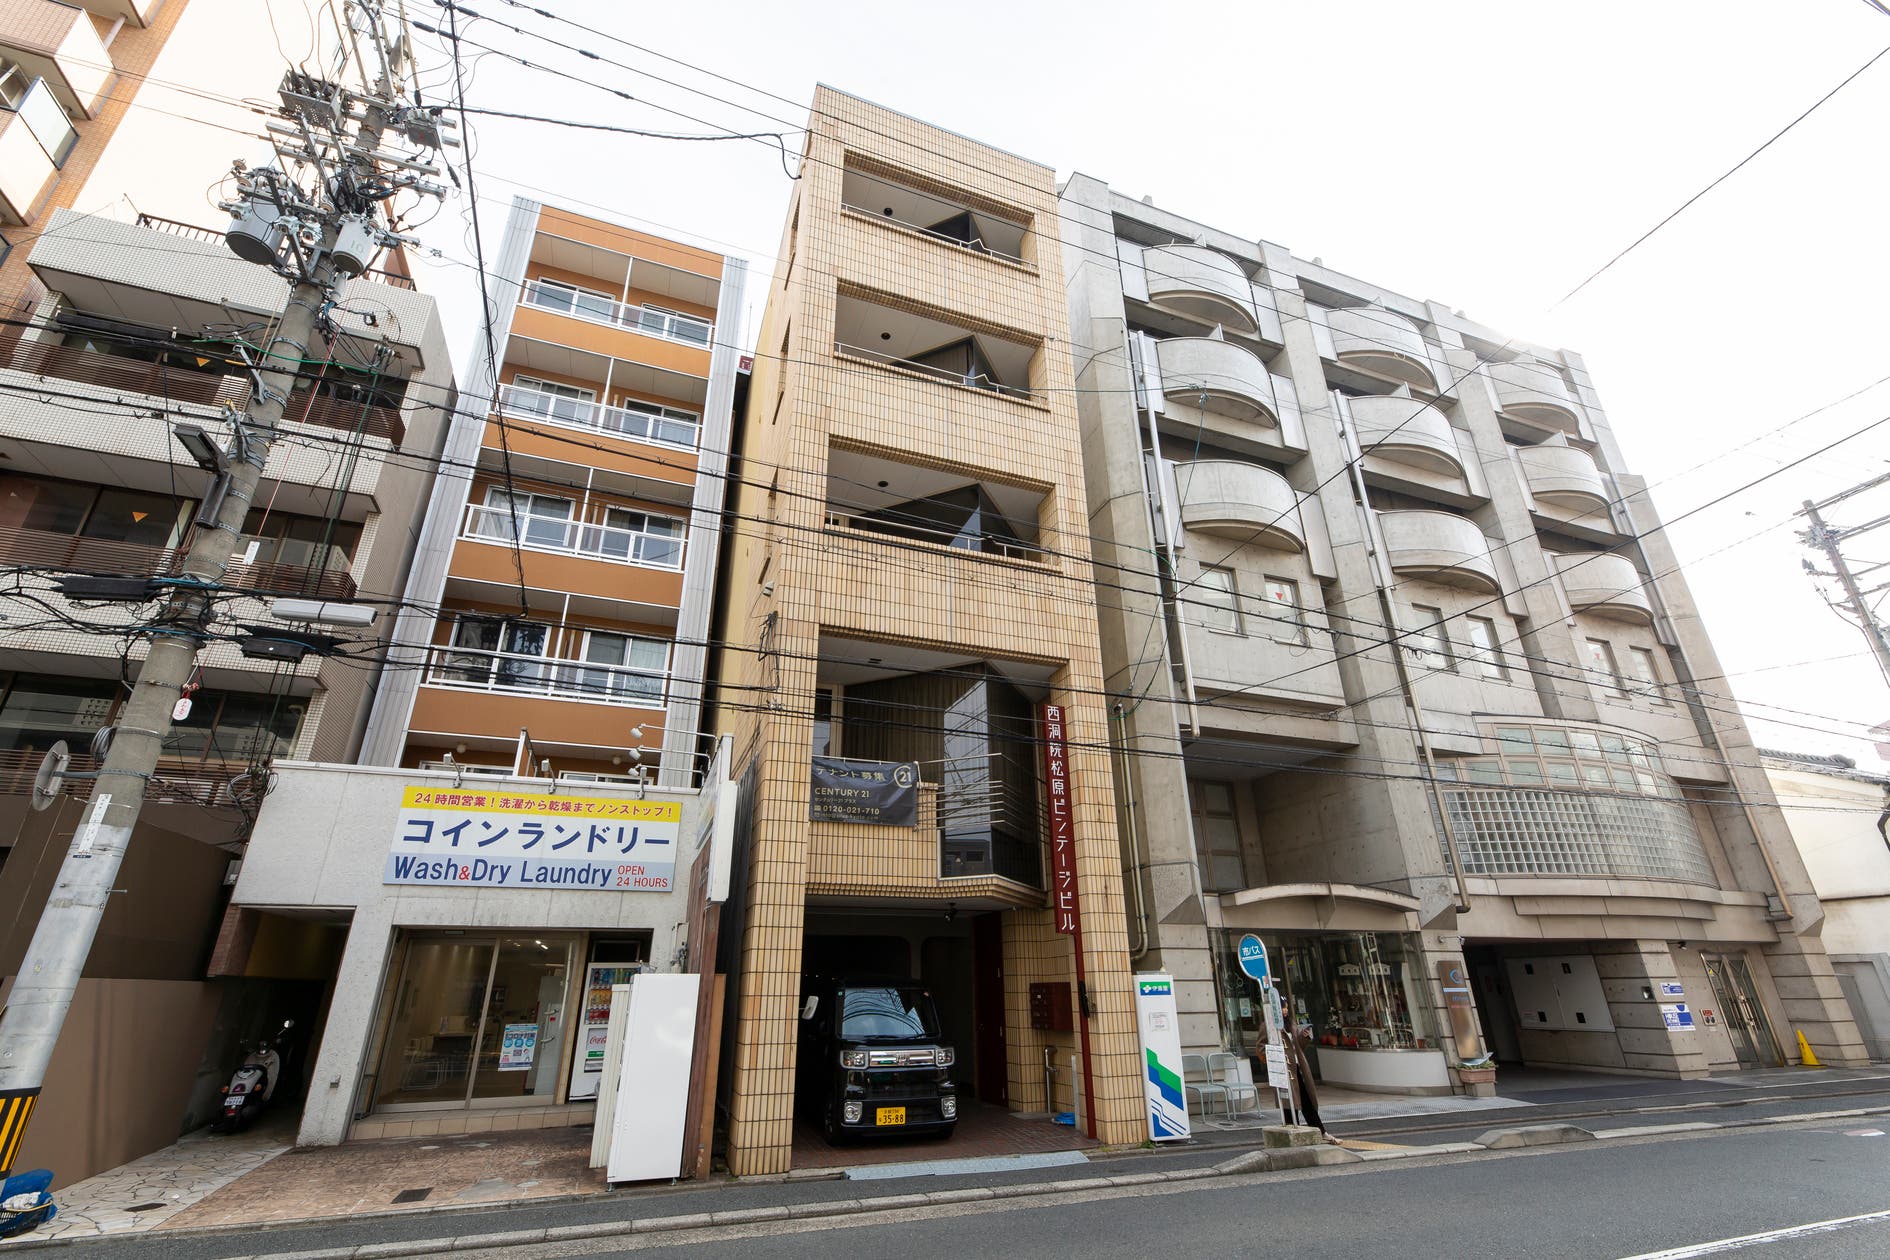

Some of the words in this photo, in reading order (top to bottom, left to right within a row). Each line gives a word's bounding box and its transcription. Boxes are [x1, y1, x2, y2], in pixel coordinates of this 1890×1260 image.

[815, 787, 859, 797] CENTURY
[861, 790, 870, 798] 21
[822, 805, 880, 815] 0120-021-710
[1047, 705, 1075, 931] 西洞院松原ビンテージビル
[402, 819, 670, 854] コインランドリー
[394, 856, 511, 883] Wash&Dry
[521, 860, 613, 887] Laundry
[617, 865, 645, 876] OPEN
[616, 876, 631, 887] 24
[633, 877, 669, 889] HOURS
[1242, 945, 1261, 956] 市バス
